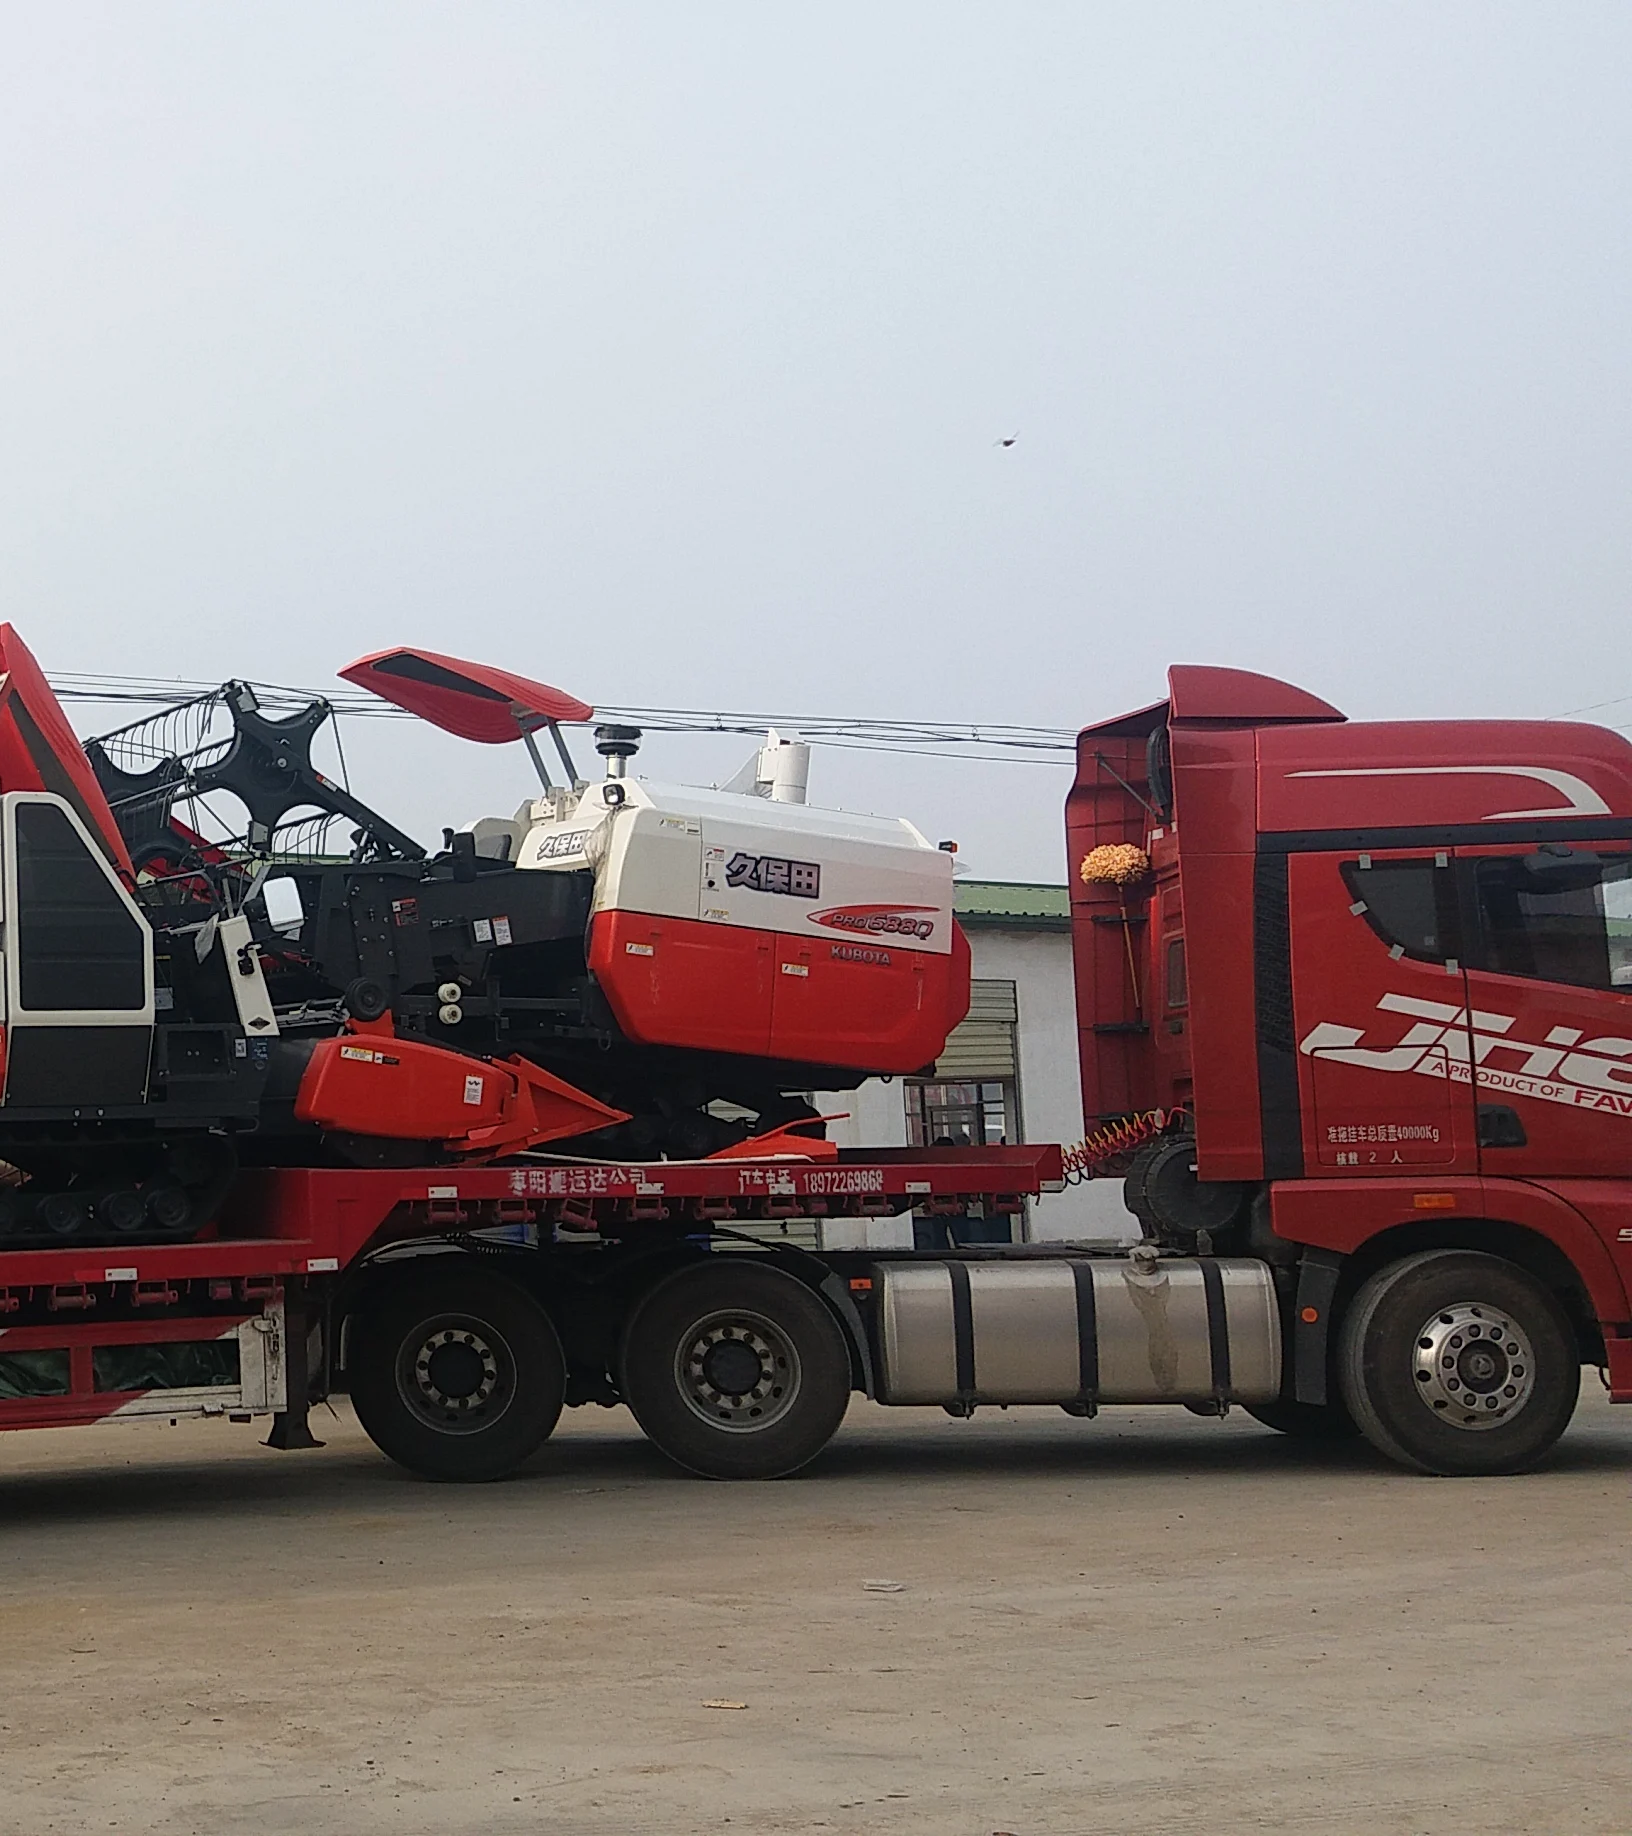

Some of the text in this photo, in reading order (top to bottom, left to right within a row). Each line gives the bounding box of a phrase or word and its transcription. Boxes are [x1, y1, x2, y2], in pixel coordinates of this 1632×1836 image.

[537, 829, 589, 860] 久保田
[726, 853, 820, 899] 久保田
[831, 946, 891, 965] KUBOTA
[1431, 1060, 1445, 1074] A
[1448, 1064, 1537, 1093] PRODUCT
[1540, 1084, 1566, 1098] OF
[1390, 1150, 1403, 1164] 人
[802, 1170, 884, 1194] 18972269868
